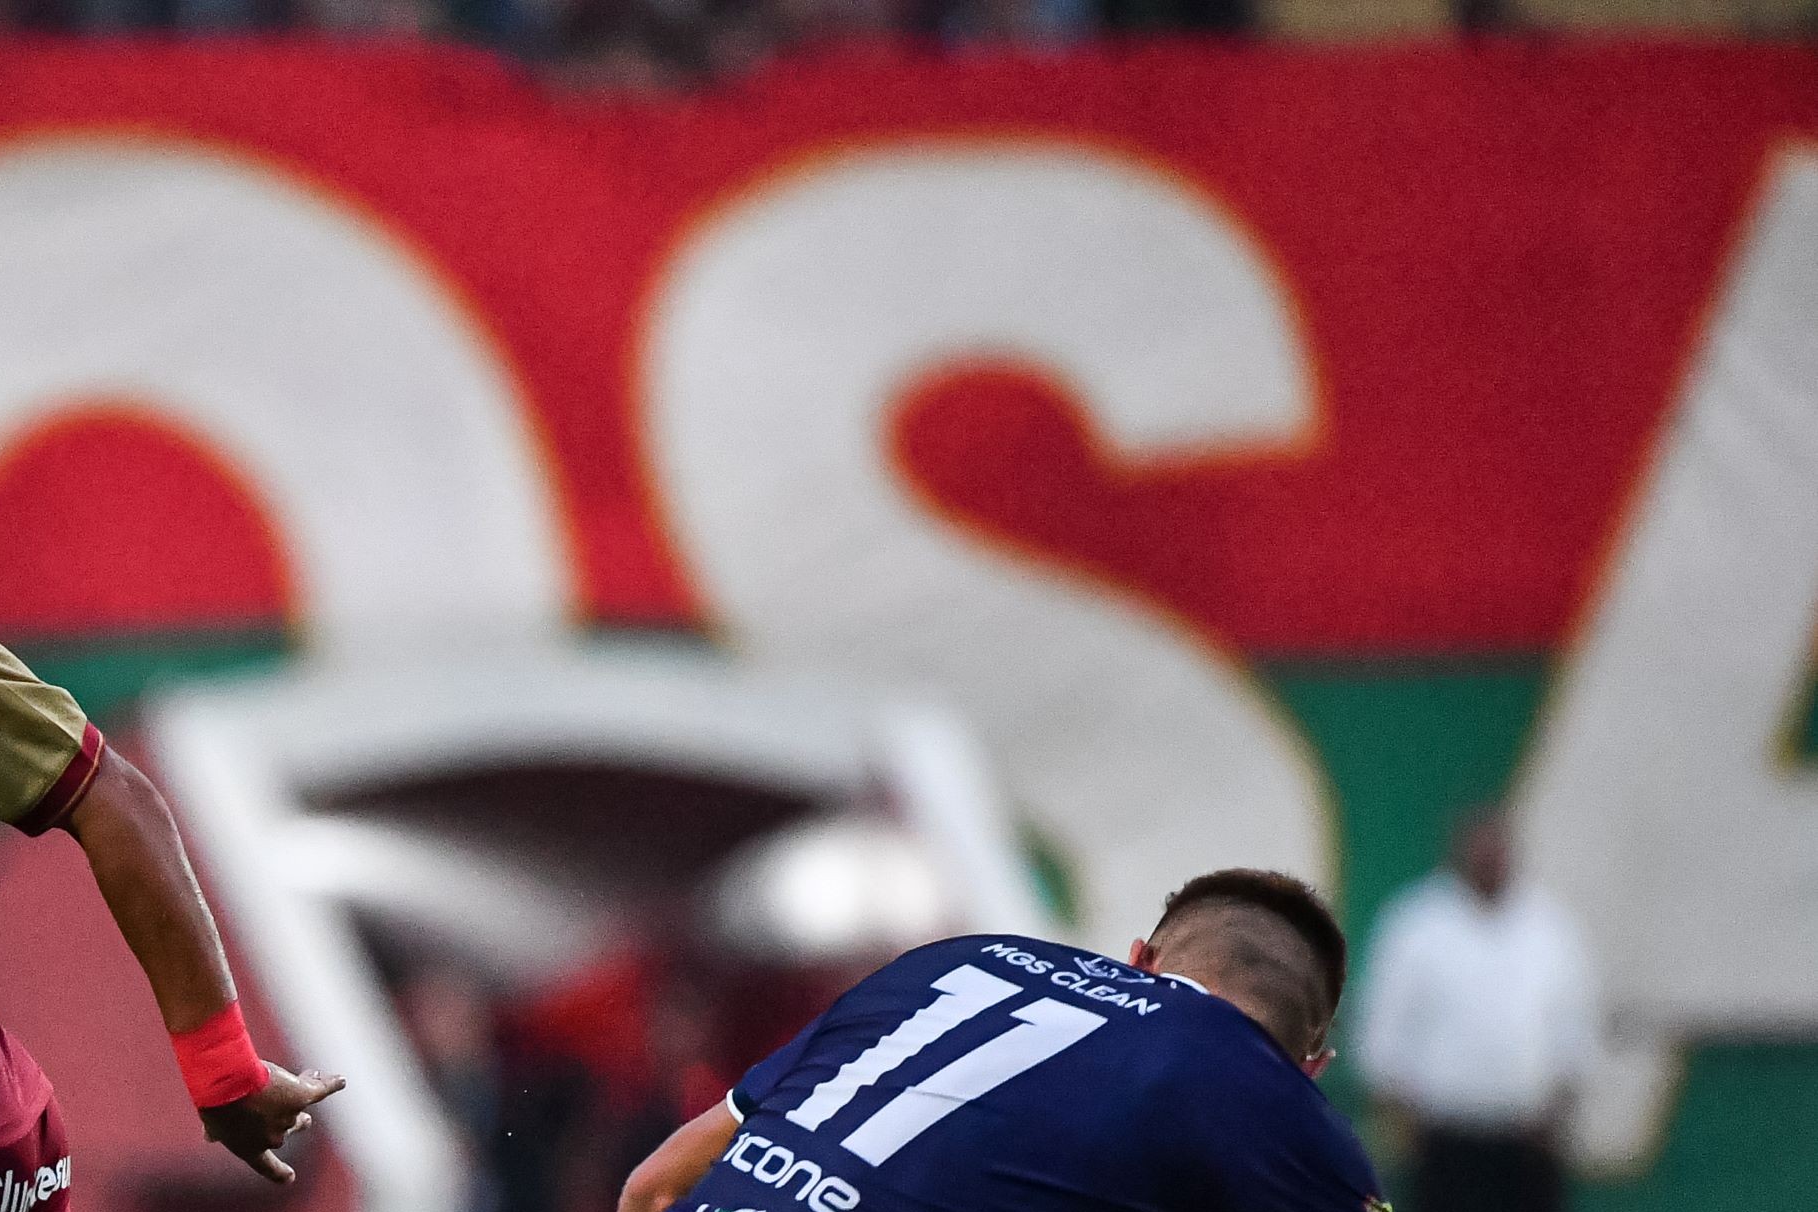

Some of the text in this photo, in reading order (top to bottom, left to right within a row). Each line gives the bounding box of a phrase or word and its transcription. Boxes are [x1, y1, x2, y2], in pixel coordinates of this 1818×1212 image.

[981, 943, 1162, 1016] MGS CLEAN
[785, 964, 1108, 1167] 11
